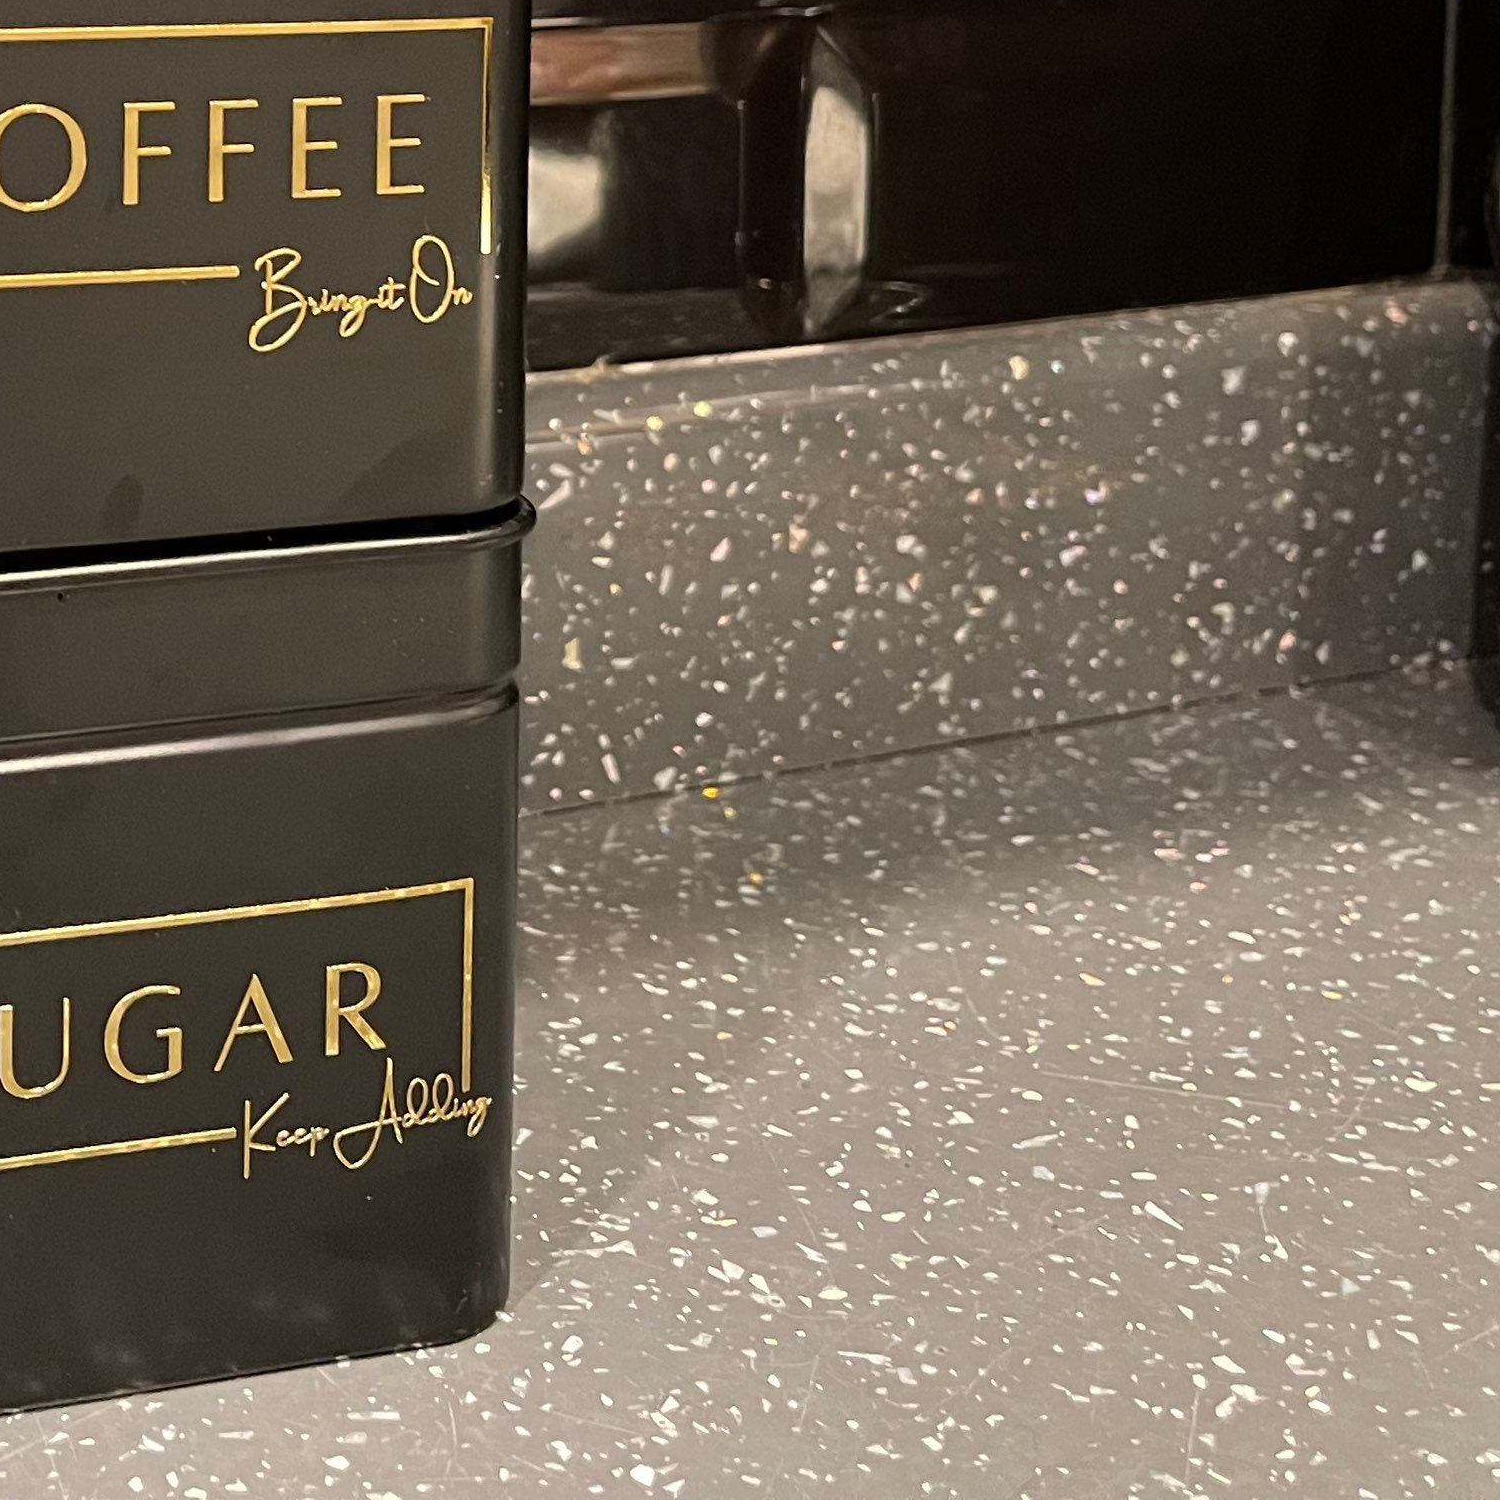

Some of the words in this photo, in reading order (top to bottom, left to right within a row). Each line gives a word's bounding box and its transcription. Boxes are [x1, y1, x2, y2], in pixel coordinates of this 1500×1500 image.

[248, 247, 372, 353] Bring
[409, 234, 474, 324] On
[243, 1092, 330, 1180] Keep
[332, 1056, 493, 1170] Adding
